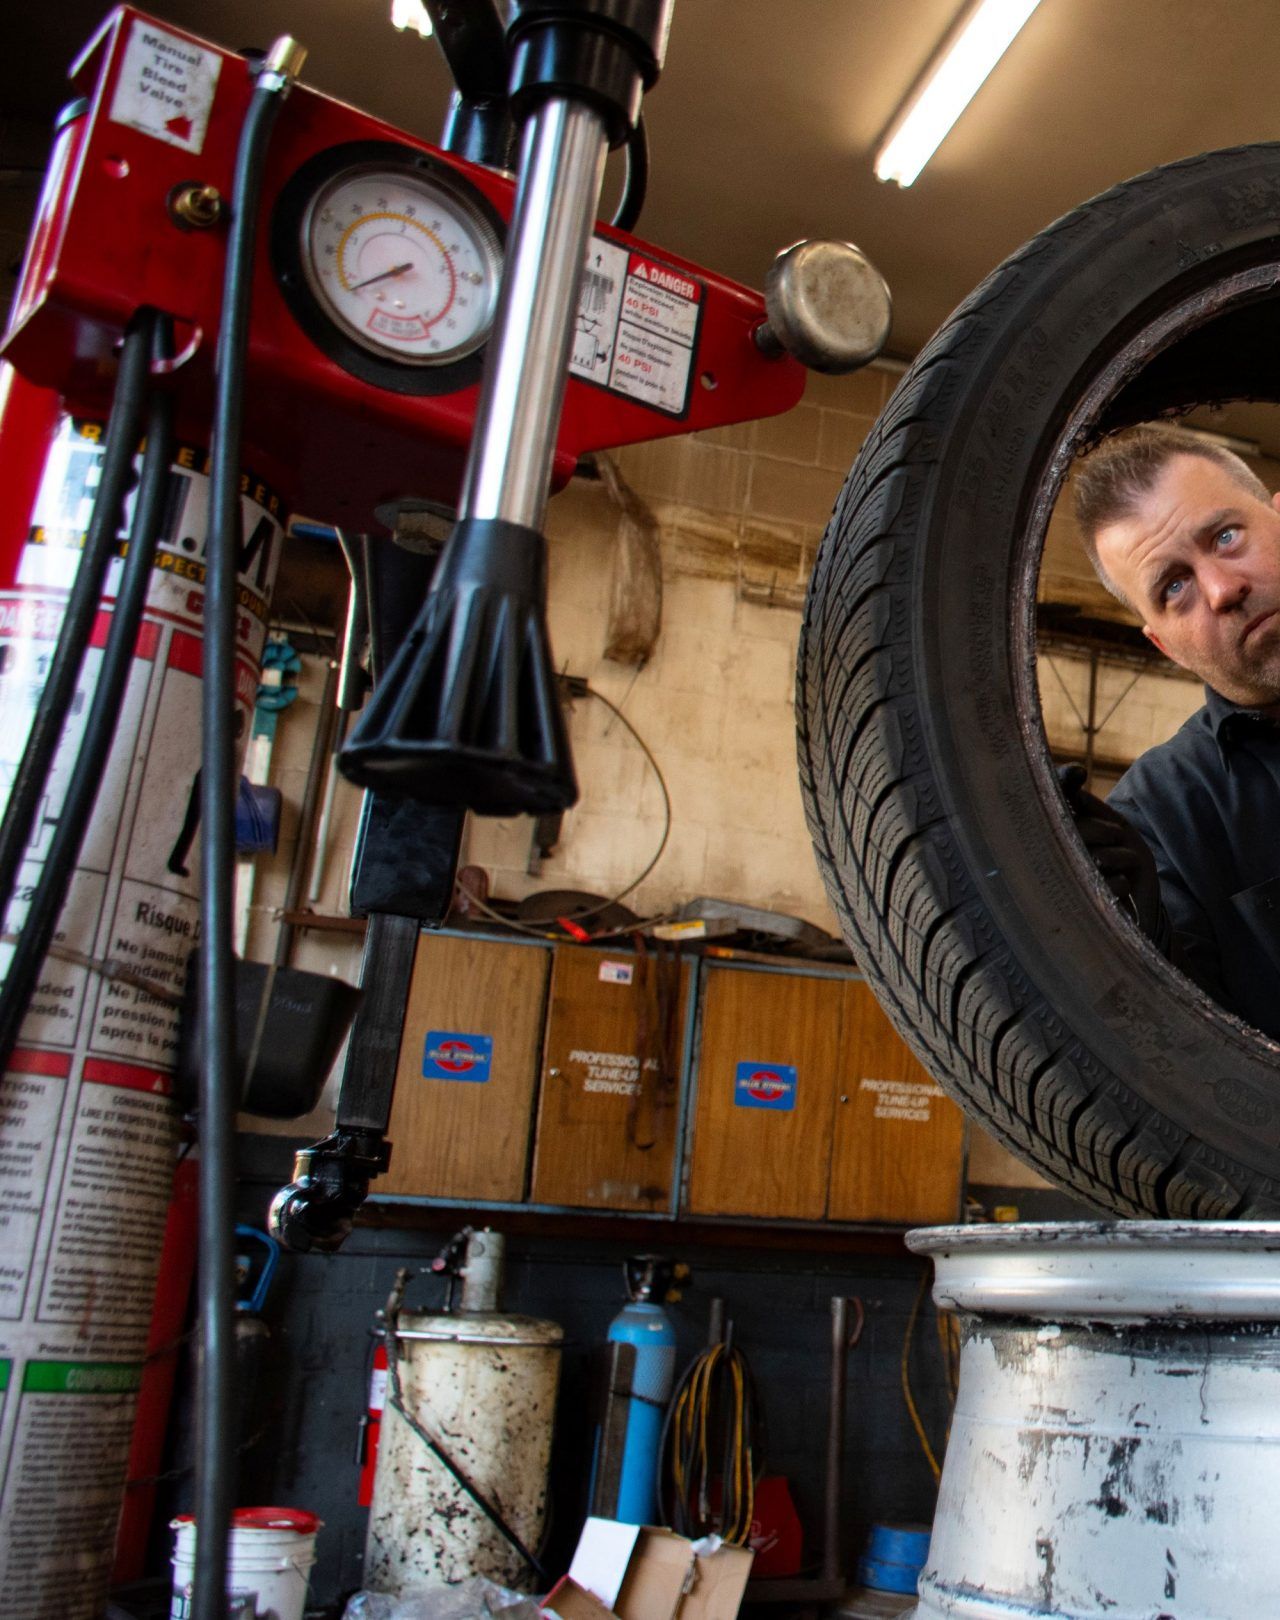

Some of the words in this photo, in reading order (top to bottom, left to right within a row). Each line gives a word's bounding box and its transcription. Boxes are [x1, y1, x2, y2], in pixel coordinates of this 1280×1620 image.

[142, 33, 203, 67] Manual
[154, 54, 184, 75] Tire
[142, 66, 187, 93] Bleed
[139, 81, 184, 108] Valve
[628, 286, 649, 299] Never
[650, 267, 695, 299] DANGER
[626, 298, 639, 309] 40
[640, 303, 659, 317] PSI
[618, 353, 631, 365] 40
[633, 358, 653, 373] PSI
[135, 901, 191, 936] Risque
[116, 938, 138, 955] Ne
[107, 984, 130, 1000] Ne
[102, 1005, 166, 1028] pression
[147, 1033, 160, 1045] la
[878, 1093, 930, 1110] TUNE-UP
[873, 1106, 931, 1122] SERVICES
